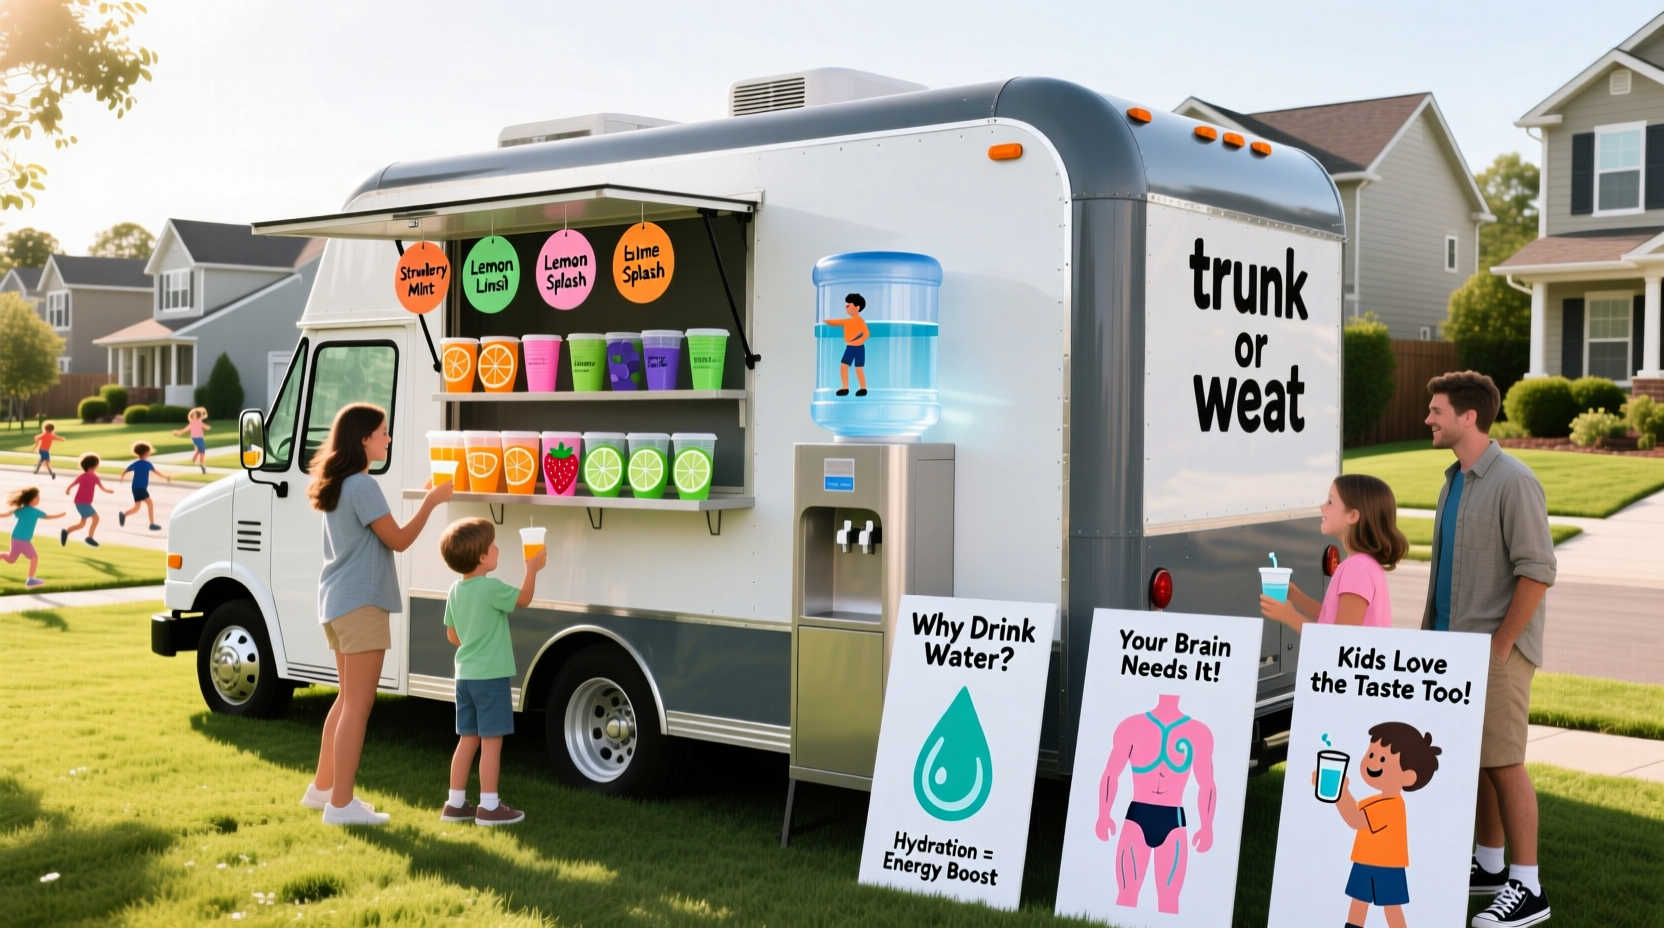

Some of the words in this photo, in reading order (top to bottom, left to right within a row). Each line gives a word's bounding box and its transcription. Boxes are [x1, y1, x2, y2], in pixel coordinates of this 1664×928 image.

[470, 259, 514, 276] Lemon
[544, 254, 588, 271] Lemon
[622, 261, 665, 287] Splash
[546, 271, 587, 296] Splash
[1189, 237, 1309, 321] trunk
[1234, 331, 1269, 369] or
[1193, 365, 1305, 434] weat
[912, 611, 965, 645] Why
[970, 615, 1036, 644] Drink
[924, 641, 1015, 672] Water?
[1119, 629, 1168, 652] Your
[1174, 632, 1231, 658] Brain
[1120, 654, 1188, 680] Needs
[1195, 660, 1221, 683] It!
[1337, 645, 1386, 671] Kids
[1393, 649, 1448, 675] Love
[1310, 670, 1347, 694] the
[1354, 674, 1415, 700] Taste
[1421, 679, 1472, 706] Too!
[893, 830, 978, 860] Hydration
[882, 850, 943, 883] Energy
[946, 861, 999, 887] Boost
